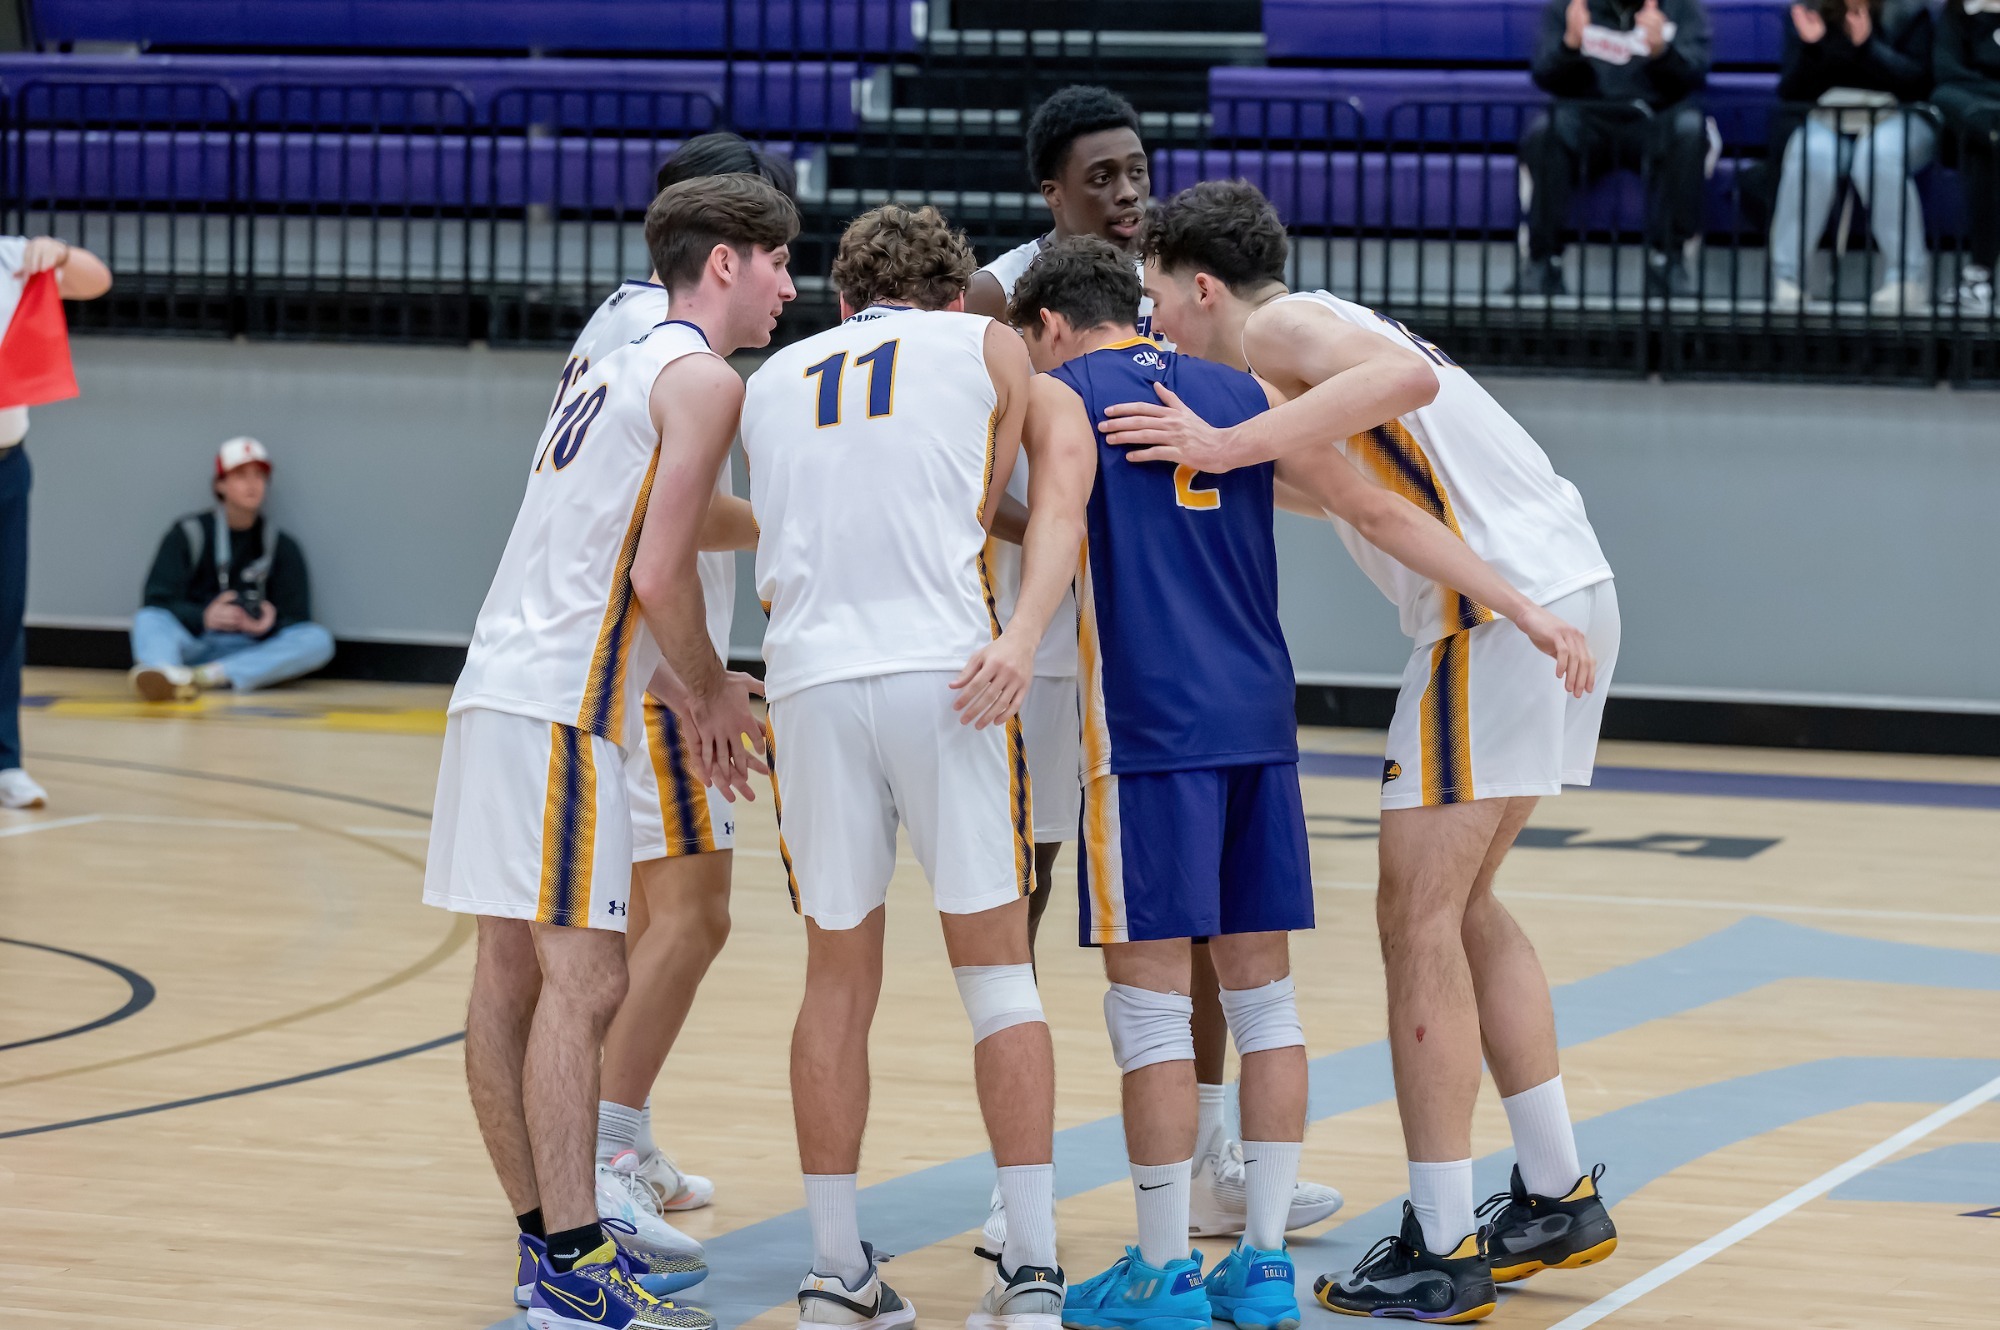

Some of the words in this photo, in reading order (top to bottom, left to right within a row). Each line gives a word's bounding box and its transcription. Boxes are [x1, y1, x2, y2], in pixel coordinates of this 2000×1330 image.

[803, 338, 900, 429] 11
[535, 382, 608, 473] 10
[1174, 462, 1221, 511] 2
[813, 1279, 824, 1291] 12
[1034, 1271, 1047, 1283] 12
